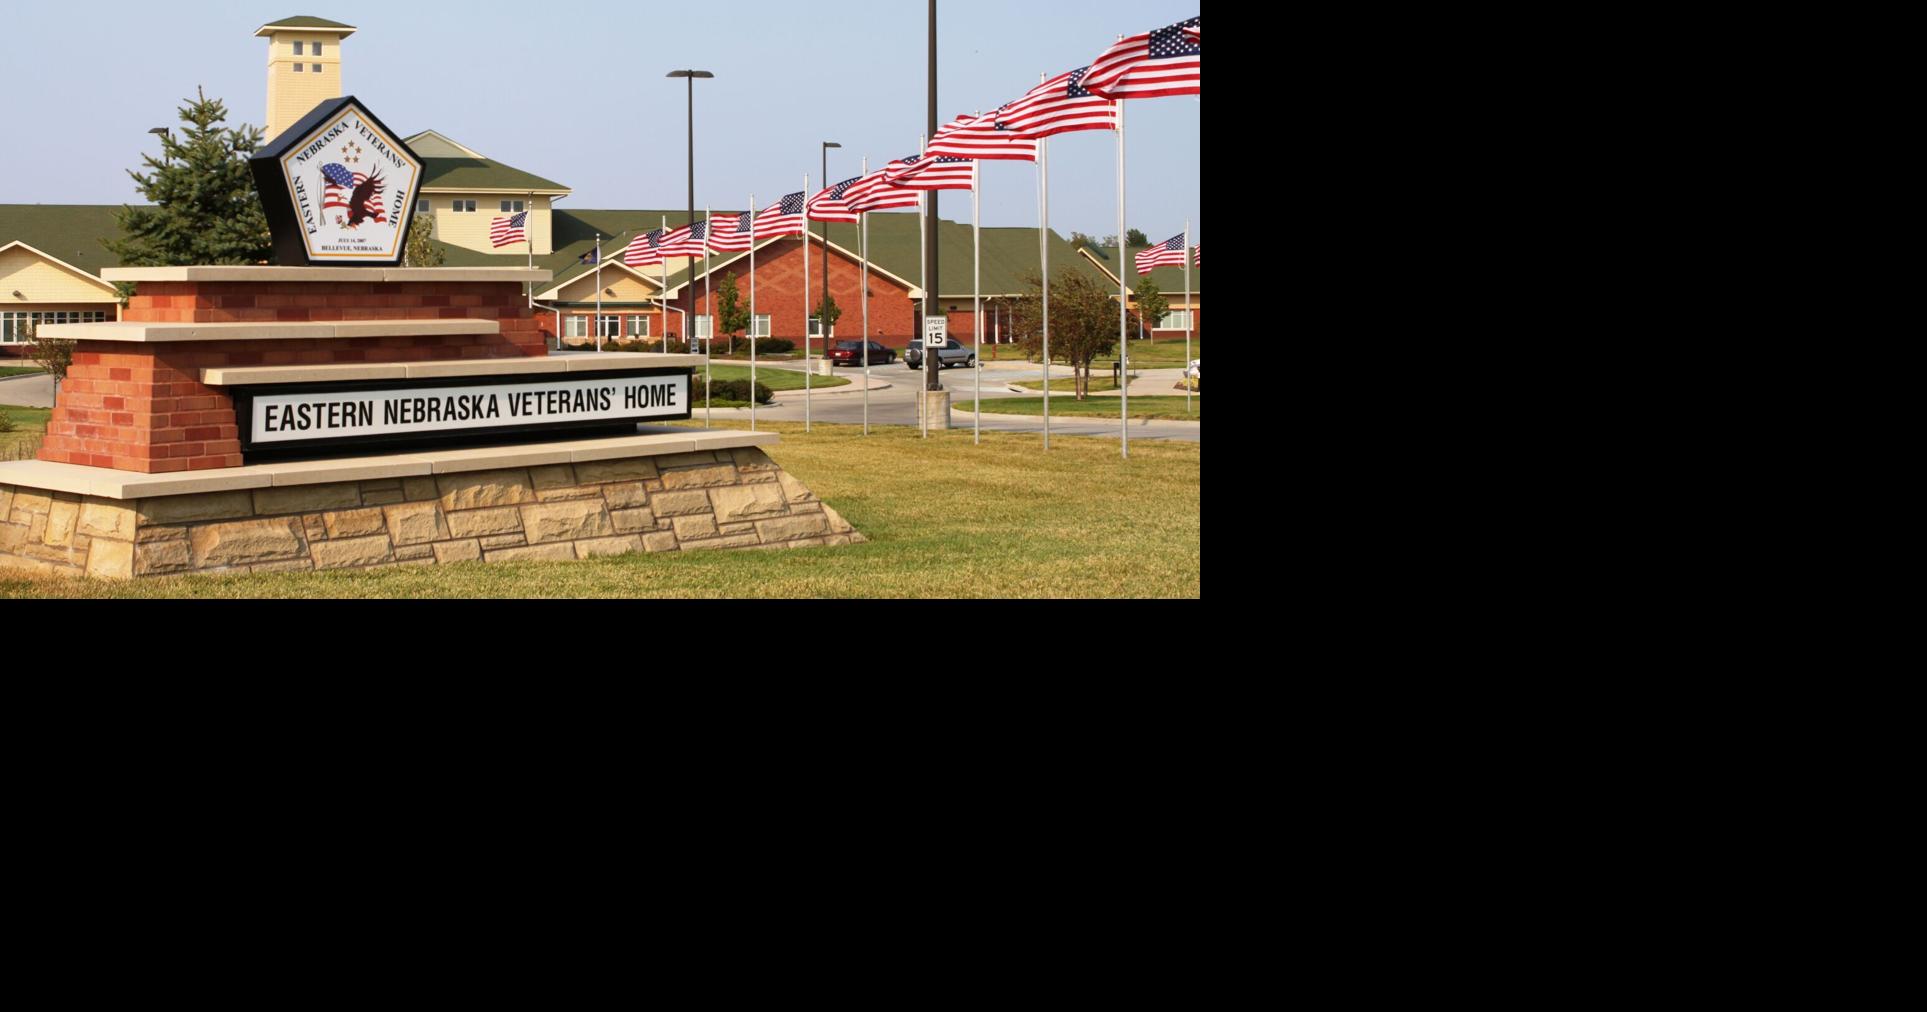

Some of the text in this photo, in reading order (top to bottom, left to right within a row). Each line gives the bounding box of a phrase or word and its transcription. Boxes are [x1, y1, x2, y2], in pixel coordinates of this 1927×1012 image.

[293, 120, 406, 235] EASTERN NEBRASKA VETERANS' HOME
[929, 333, 943, 344] 15
[265, 383, 677, 431] EASTERN NEBRASKA VETERANS' HOME
